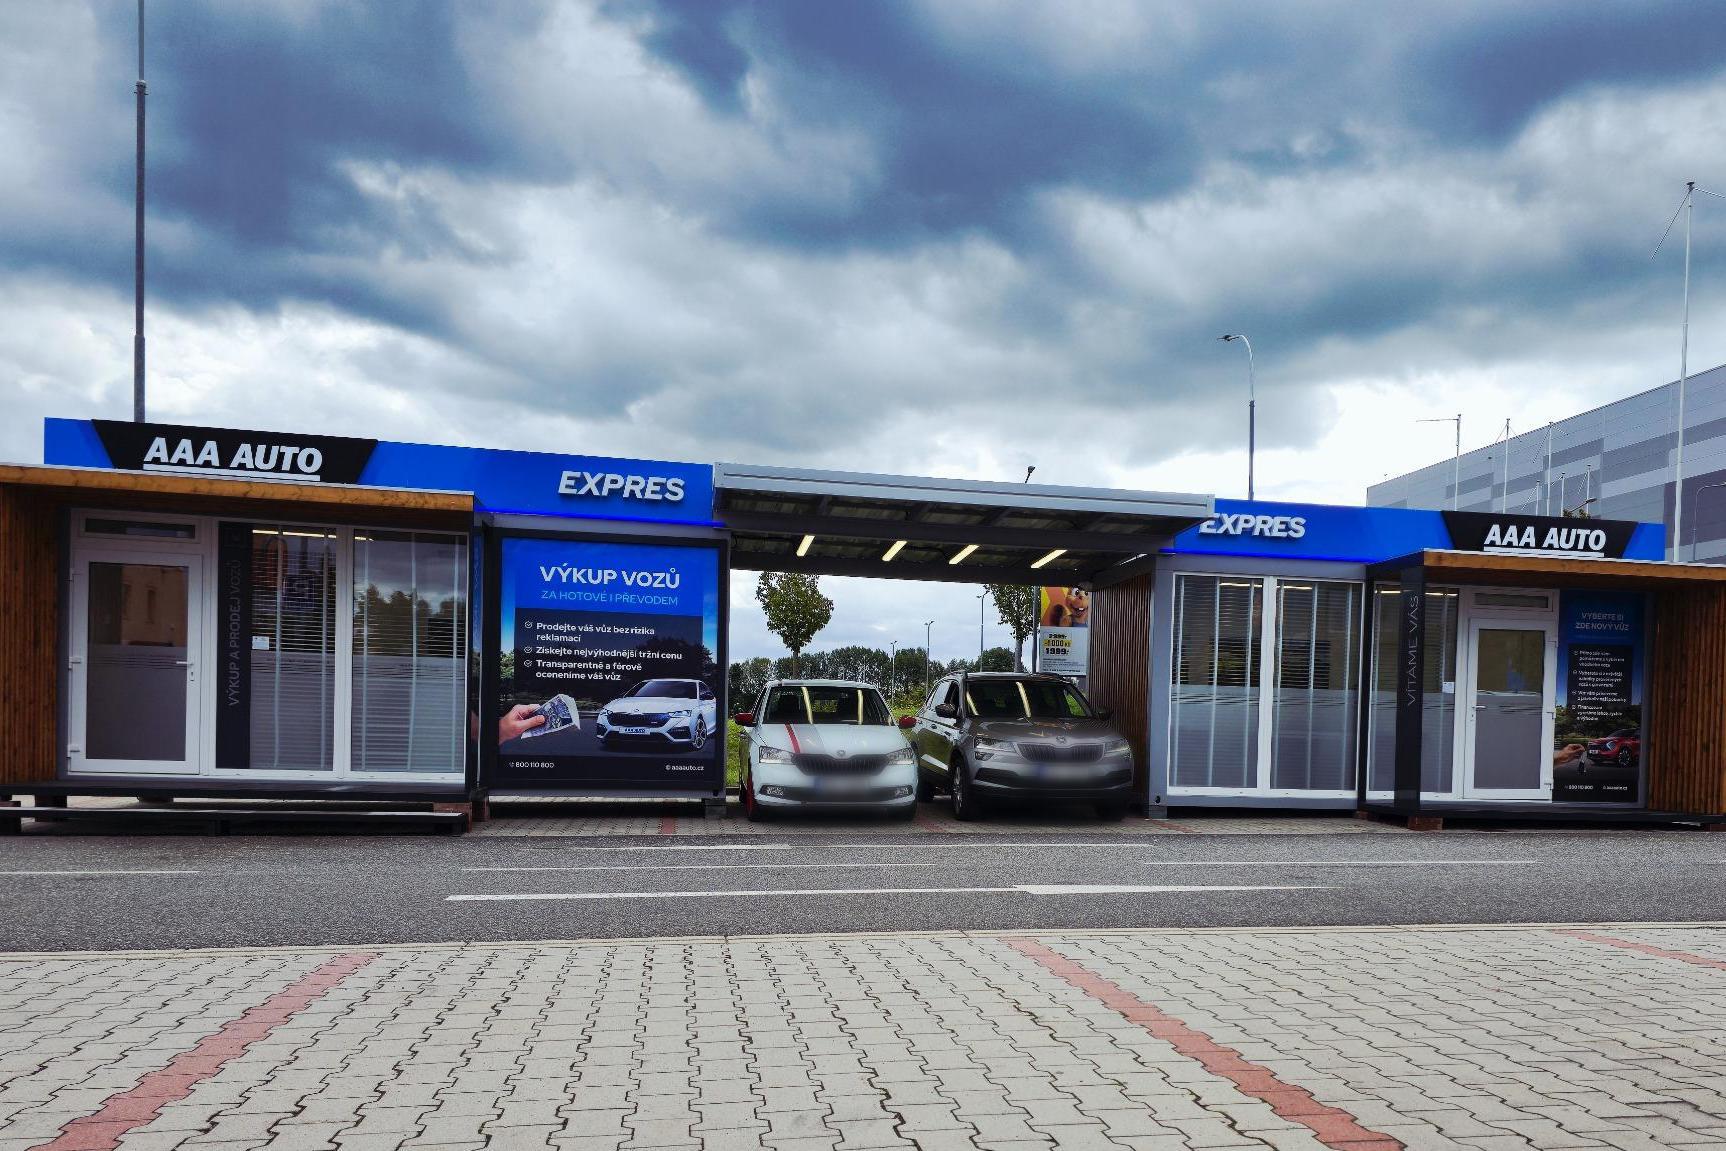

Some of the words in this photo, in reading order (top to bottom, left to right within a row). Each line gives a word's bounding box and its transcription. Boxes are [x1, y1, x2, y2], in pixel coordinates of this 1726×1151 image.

[144, 436, 220, 467] AAA
[230, 443, 323, 474] AUTO
[558, 470, 685, 501] EXPRES
[1199, 512, 1307, 538] EXPRES
[1484, 524, 1536, 548] AAA
[1542, 527, 1607, 551] AUTO
[540, 562, 618, 585] VÝKUP
[621, 567, 680, 589] VOZŮ
[541, 590, 557, 600] ZA
[560, 590, 607, 602] HOTOVÉ
[615, 592, 678, 606] PŘEVODEM
[228, 597, 241, 649] PRODEJ
[1407, 595, 1419, 633] VÁS
[536, 622, 576, 632] Prodejte
[577, 624, 594, 632] váš
[595, 624, 612, 633] vůz
[613, 625, 630, 634] bez
[630, 626, 655, 635] rizika
[536, 633, 581, 642] reklamací
[229, 651, 241, 660] A
[536, 646, 573, 656] Získejte
[574, 648, 637, 659] nejvýhodnější
[639, 650, 660, 659] tržní
[536, 660, 604, 670] Transparentně
[226, 662, 241, 706] VÝKUP
[587, 672, 604, 680] váš
[604, 672, 622, 681] vůz
[1405, 636, 1418, 706] VÍTÁME
